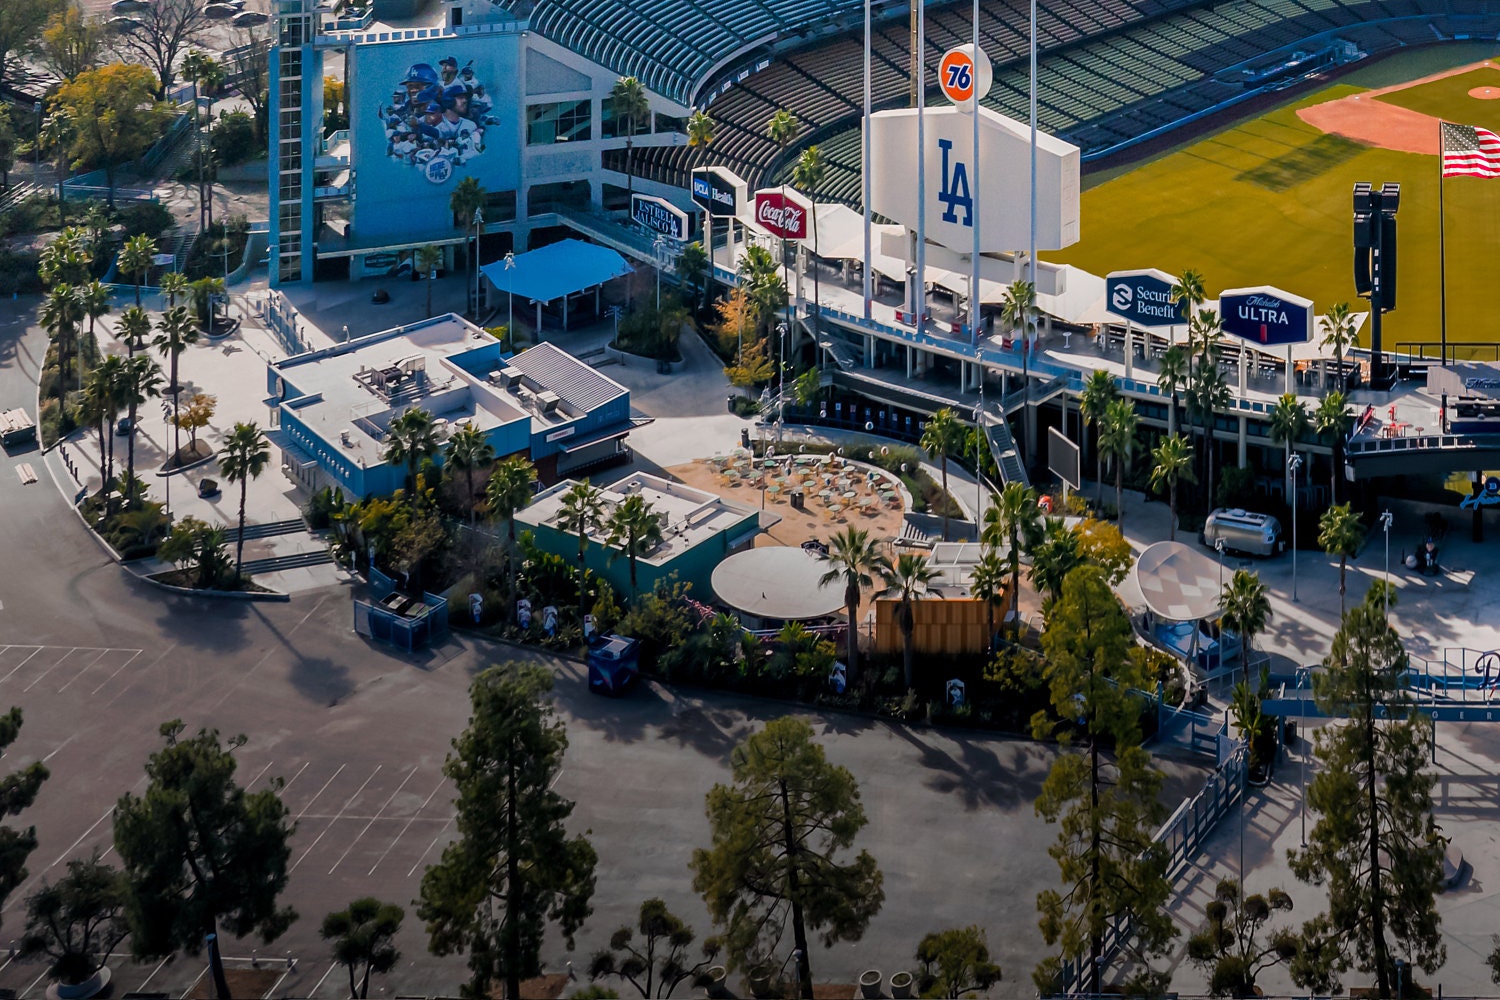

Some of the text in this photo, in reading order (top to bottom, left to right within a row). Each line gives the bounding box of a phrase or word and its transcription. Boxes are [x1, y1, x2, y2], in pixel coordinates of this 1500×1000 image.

[946, 63, 972, 91] 76
[694, 181, 709, 196] UCLA
[938, 138, 973, 227] LA
[635, 210, 669, 233] JALISCO
[1137, 300, 1175, 319] Benefit
[1238, 305, 1289, 325] ULTRA
